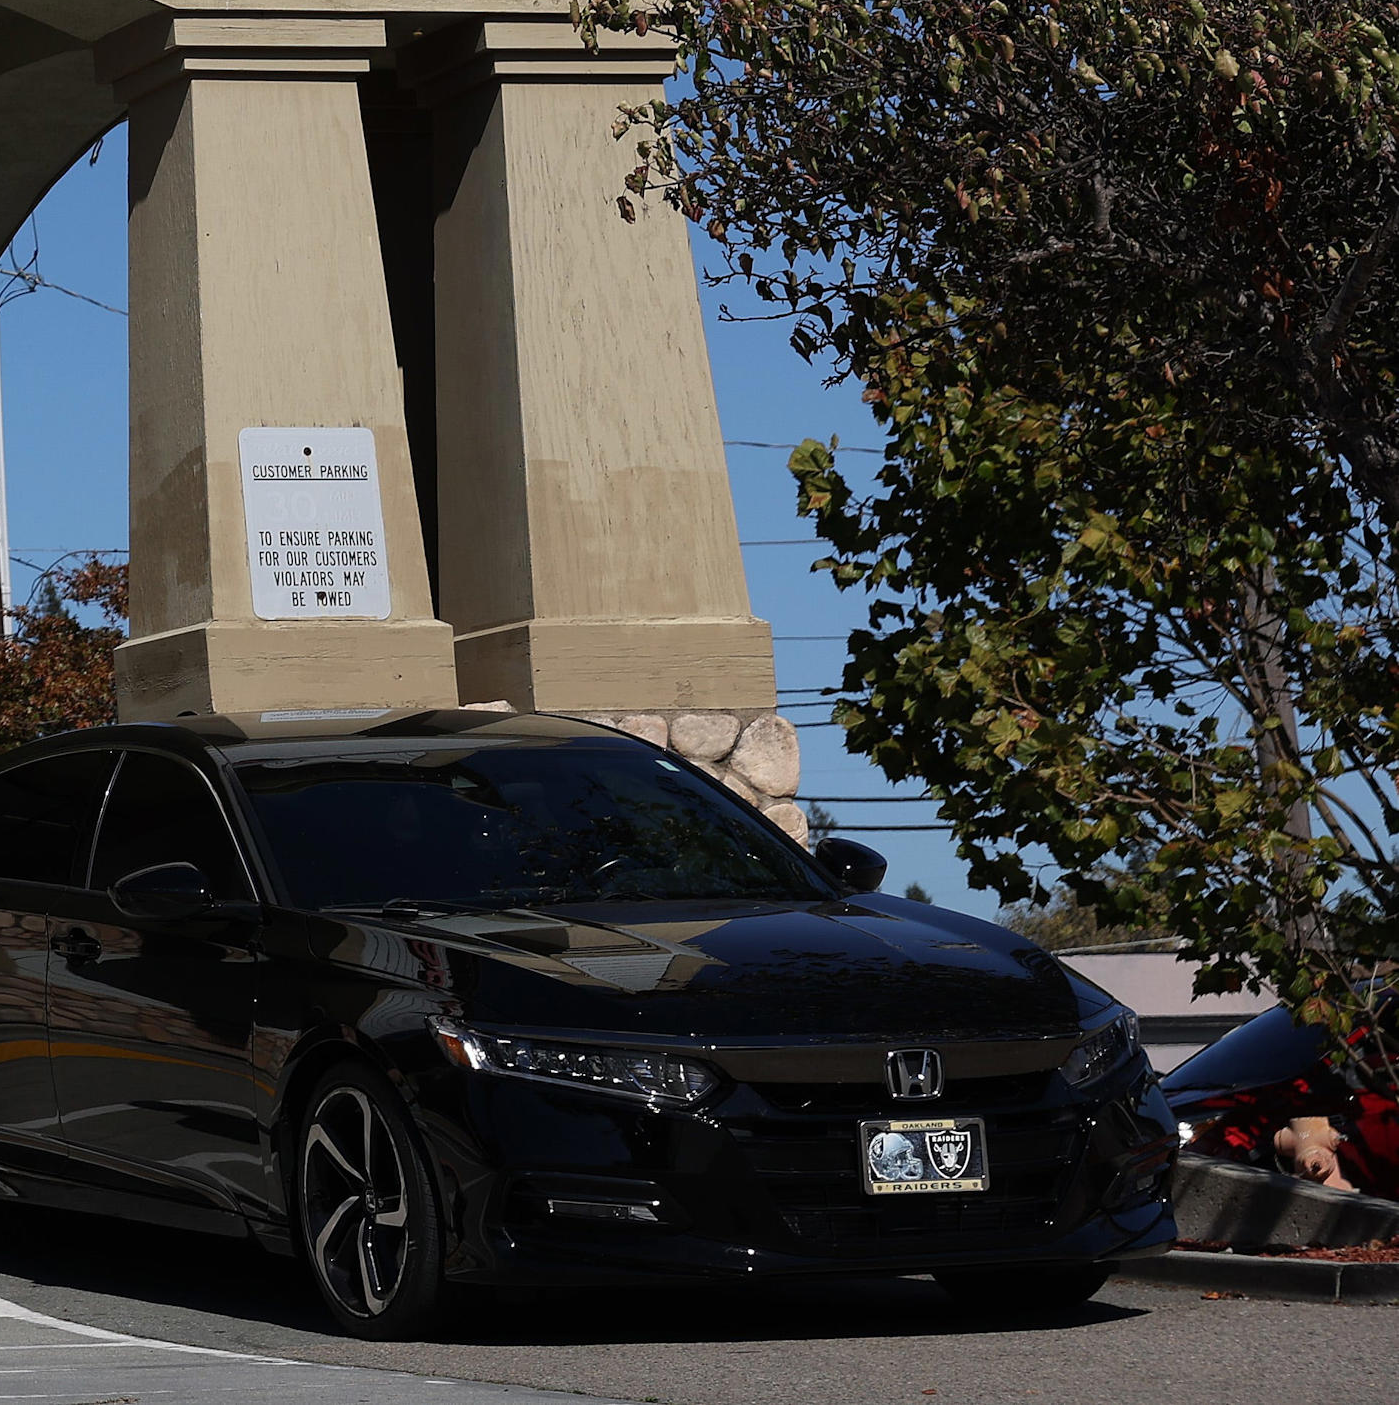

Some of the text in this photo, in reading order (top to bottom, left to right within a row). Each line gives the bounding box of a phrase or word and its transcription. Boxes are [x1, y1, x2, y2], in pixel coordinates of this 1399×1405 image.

[253, 465, 368, 478] CUSTOMER PARKING
[259, 531, 373, 546] TO ENSURE PARKING
[259, 551, 377, 566] FOR OUR CUSTOMERS
[274, 571, 365, 586] VIOLATORS MAY
[292, 592, 306, 606] BE
[931, 1135, 965, 1143] RAIDERS
[892, 1182, 963, 1192] RAIDERS
